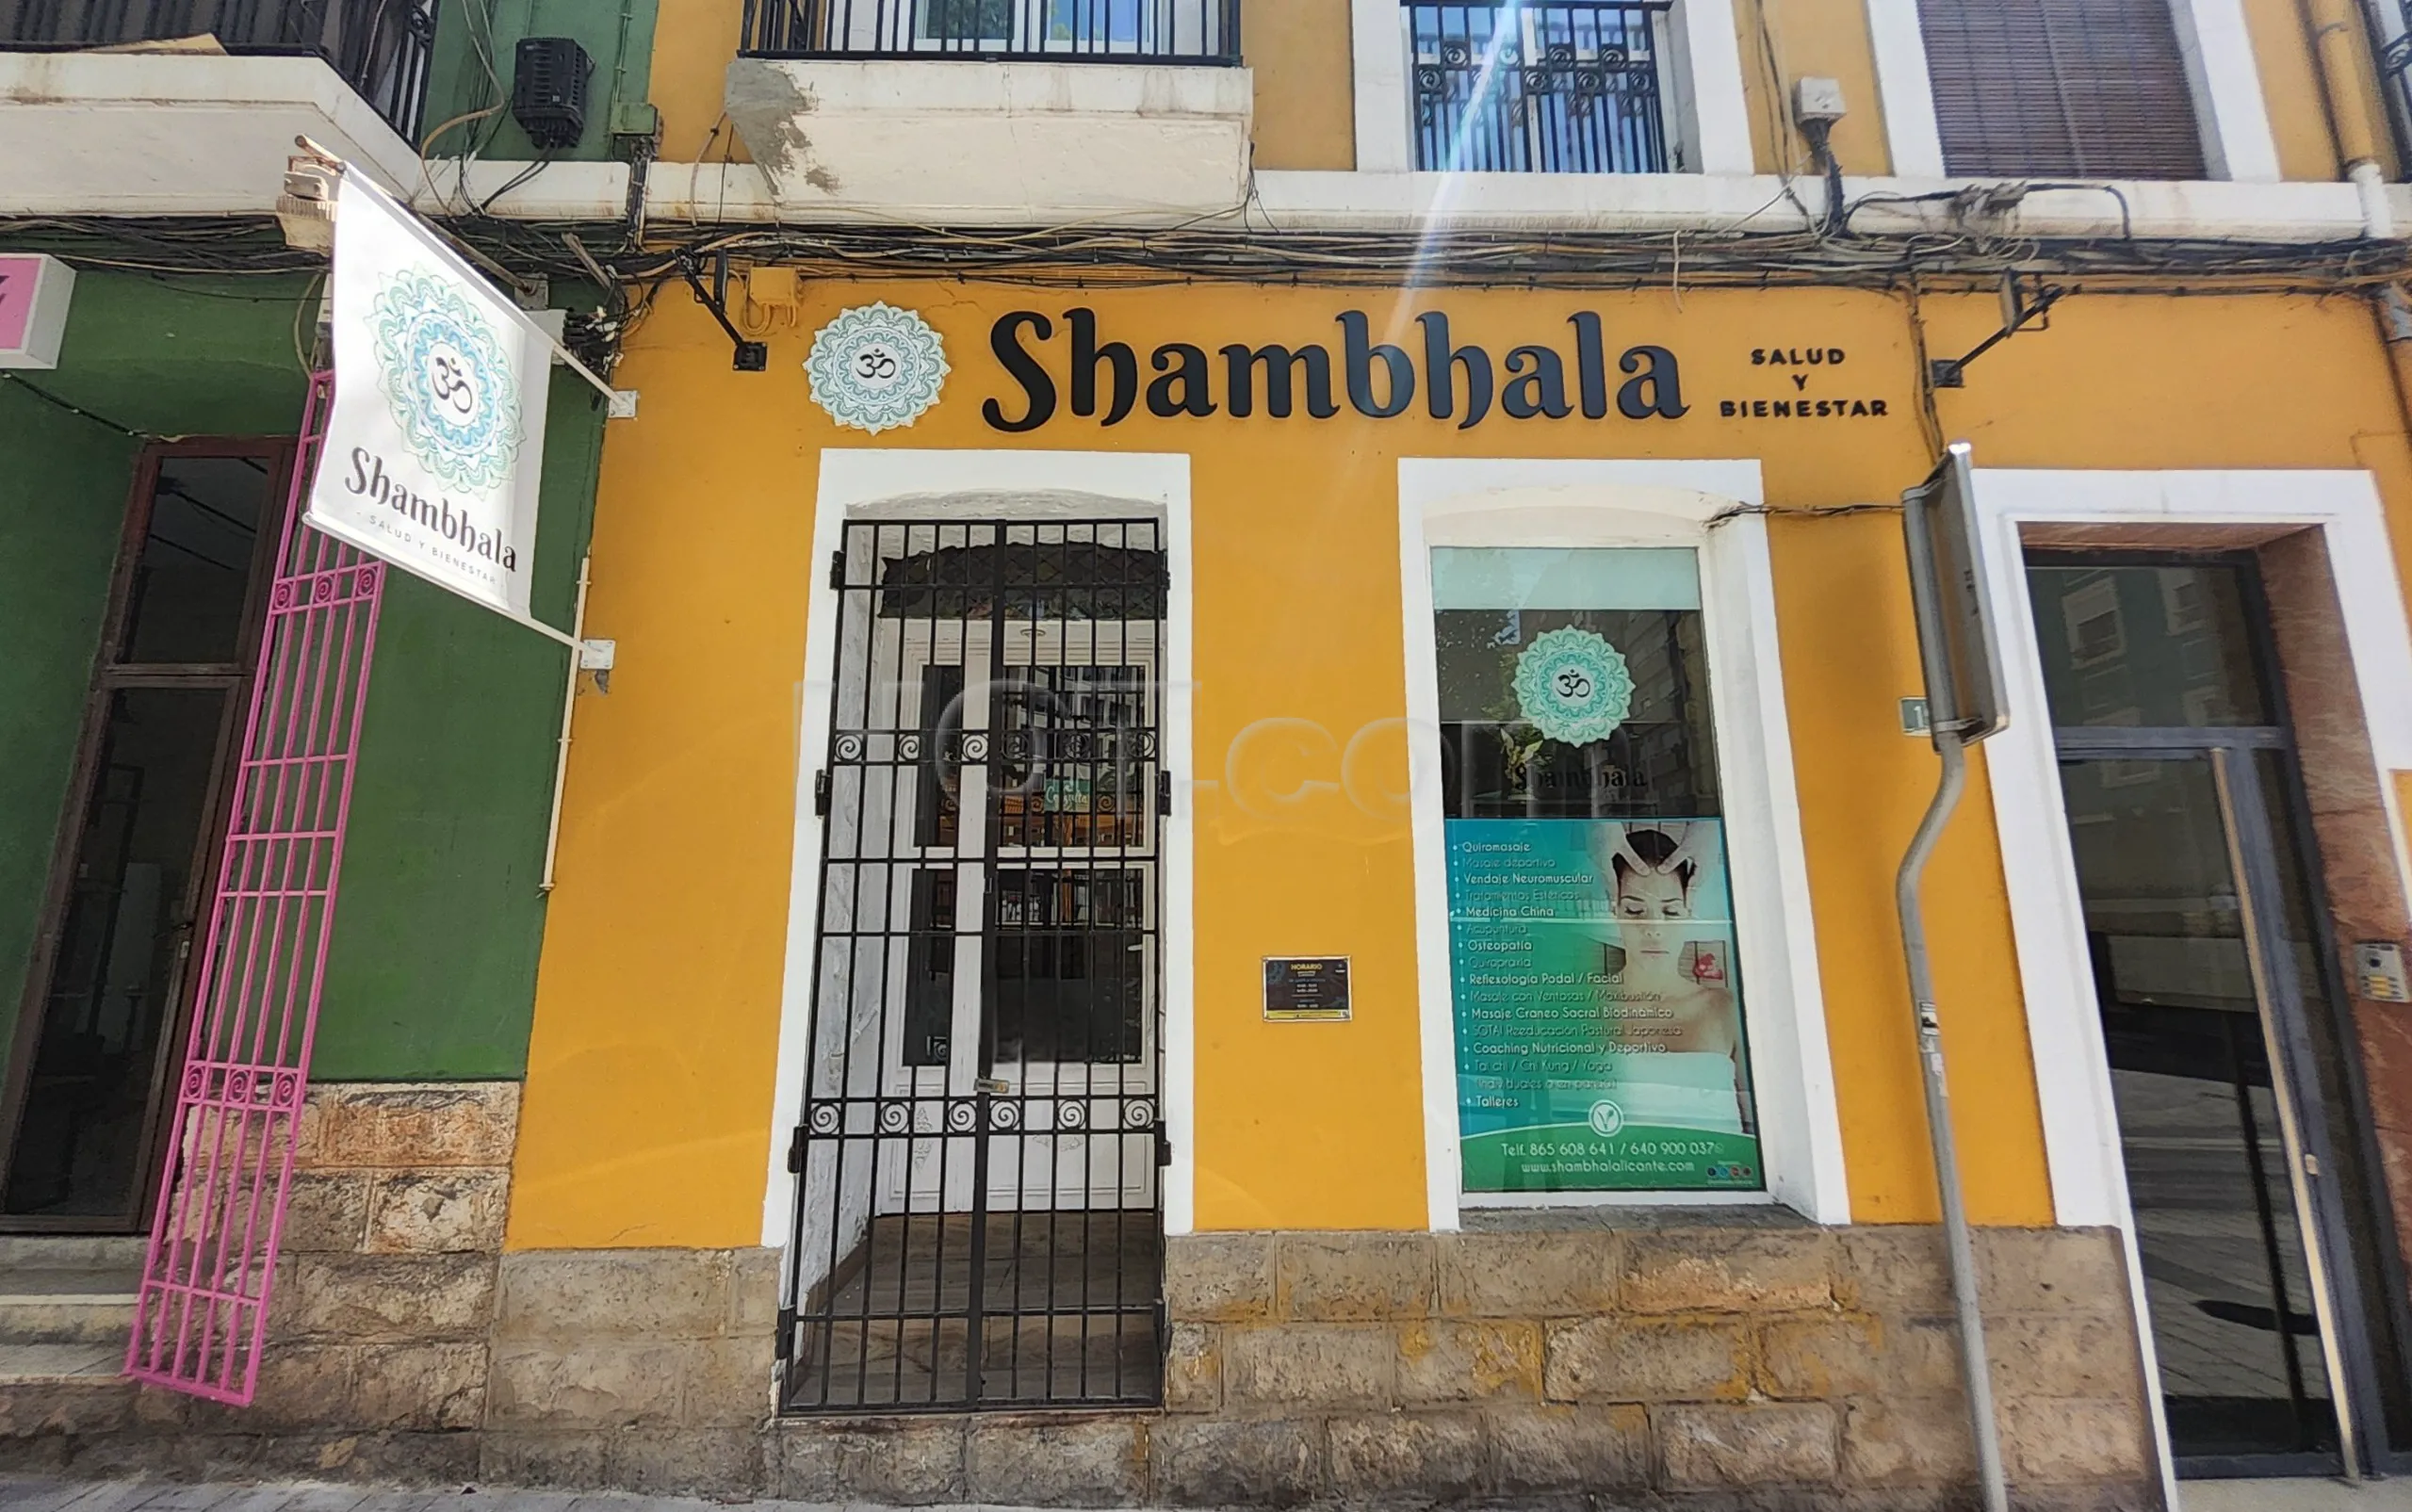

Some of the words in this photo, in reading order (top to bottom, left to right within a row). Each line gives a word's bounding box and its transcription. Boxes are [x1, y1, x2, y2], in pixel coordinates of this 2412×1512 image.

[1751, 348, 1846, 366] SALUD
[982, 307, 1691, 433] Shambhala
[1791, 374, 1809, 392] Y
[1719, 399, 1888, 418] BIENESTAR
[345, 447, 517, 573] Shambhala
[368, 514, 412, 543] SALUD
[432, 546, 497, 586] BIENESTAR
[1461, 841, 1531, 854] Quiromasaje
[1463, 872, 1508, 886] Vendaje
[1512, 872, 1593, 884] Neuromuscular
[1466, 906, 1518, 918] Medicina
[1521, 905, 1555, 917] China
[1467, 939, 1533, 952] Osteopatía
[1469, 972, 1539, 986] Reflexología
[1541, 972, 1575, 984] Podal
[1587, 972, 1623, 984] Facial
[1471, 1007, 1512, 1019] Masaje
[1562, 1006, 1600, 1018] Sacral
[1473, 1042, 1529, 1055] Coaching
[1532, 1042, 1595, 1053] Nutricional
[1600, 1044, 1607, 1055] y
[1608, 1041, 1667, 1054] Deportivo
[1475, 1095, 1520, 1109] Talleres
[1529, 1143, 1555, 1156] 865
[1559, 1143, 1585, 1156] 608
[1589, 1142, 1615, 1156] 641
[1630, 1142, 1656, 1155] 640
[1661, 1142, 1687, 1155] 900
[1689, 1142, 1715, 1155] 037
